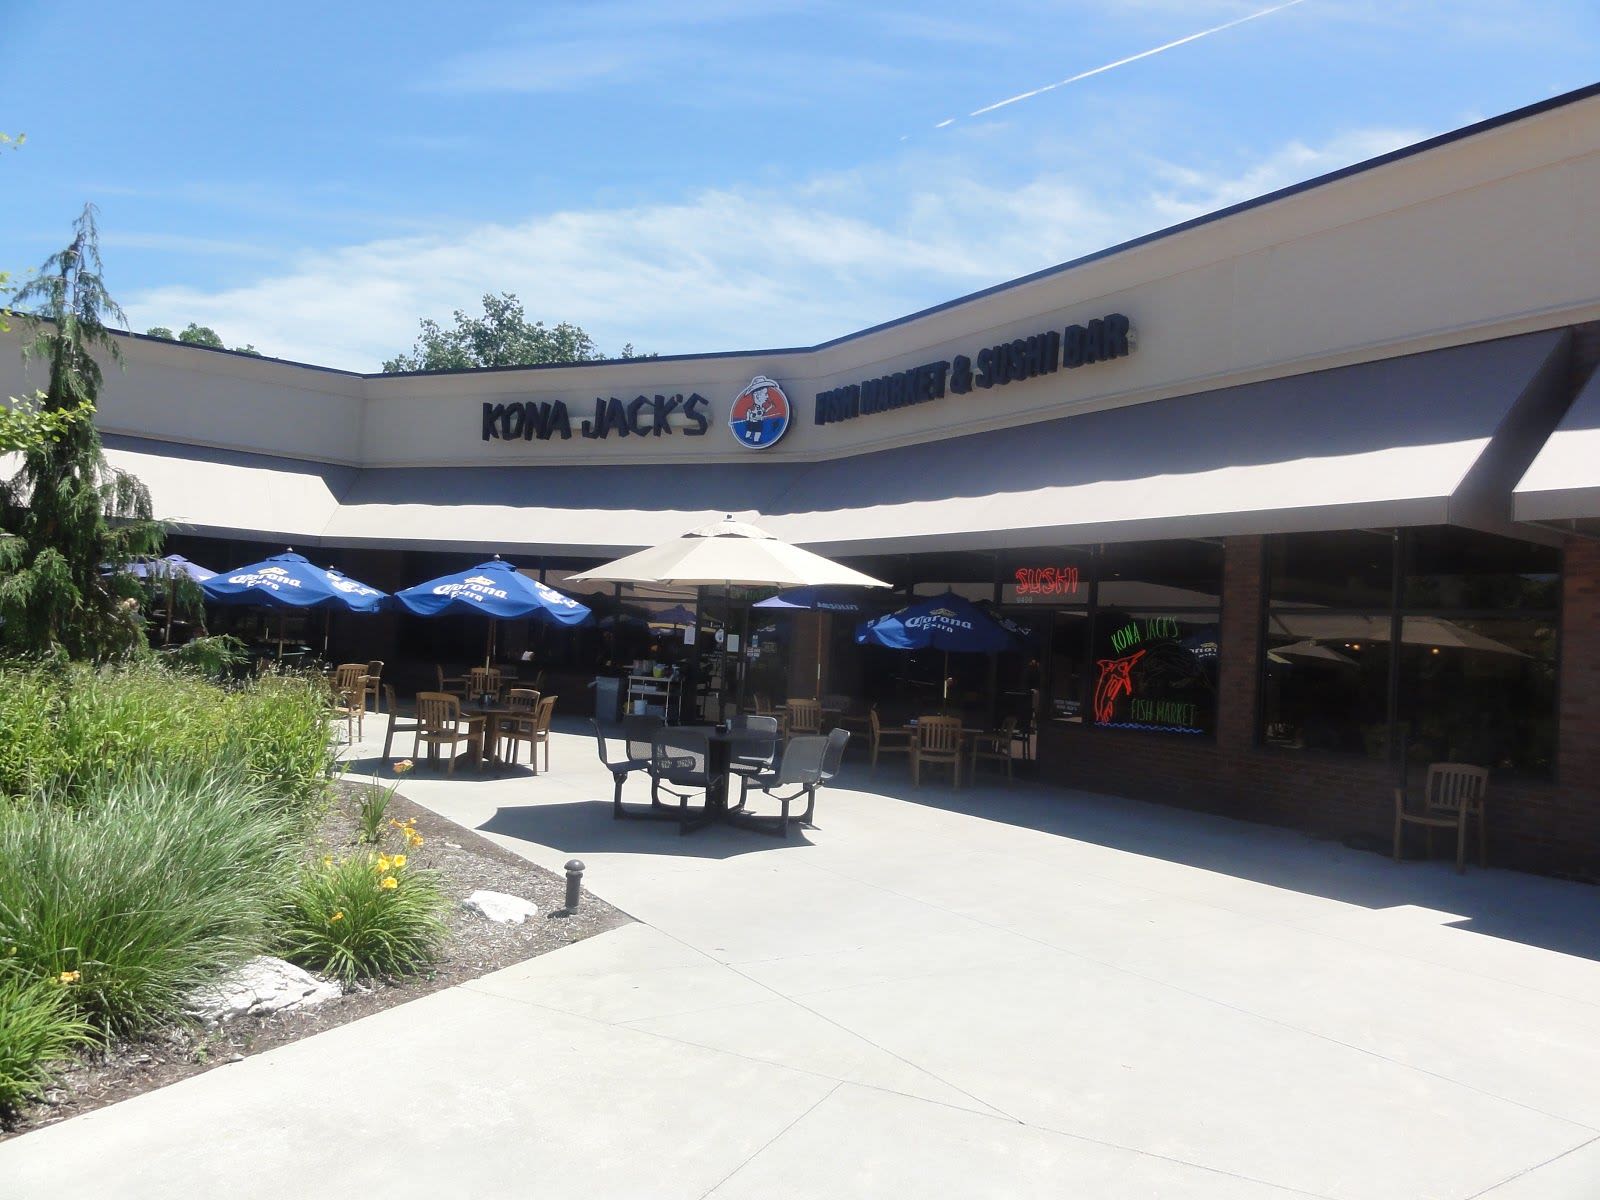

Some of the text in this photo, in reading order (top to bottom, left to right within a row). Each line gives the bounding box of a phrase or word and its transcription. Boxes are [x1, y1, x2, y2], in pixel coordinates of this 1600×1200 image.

[950, 355, 973, 395] &
[975, 331, 1060, 389] SUSHI
[1063, 313, 1129, 369] BAR
[482, 393, 709, 441] KONA JACK'S
[229, 573, 302, 589] Corona
[433, 583, 507, 600] Corona
[1015, 567, 1079, 594] SUSHI
[905, 614, 973, 631] Corona
[1111, 616, 1178, 653] KONA JACK'S
[1131, 699, 1197, 725] FISH MARKET
